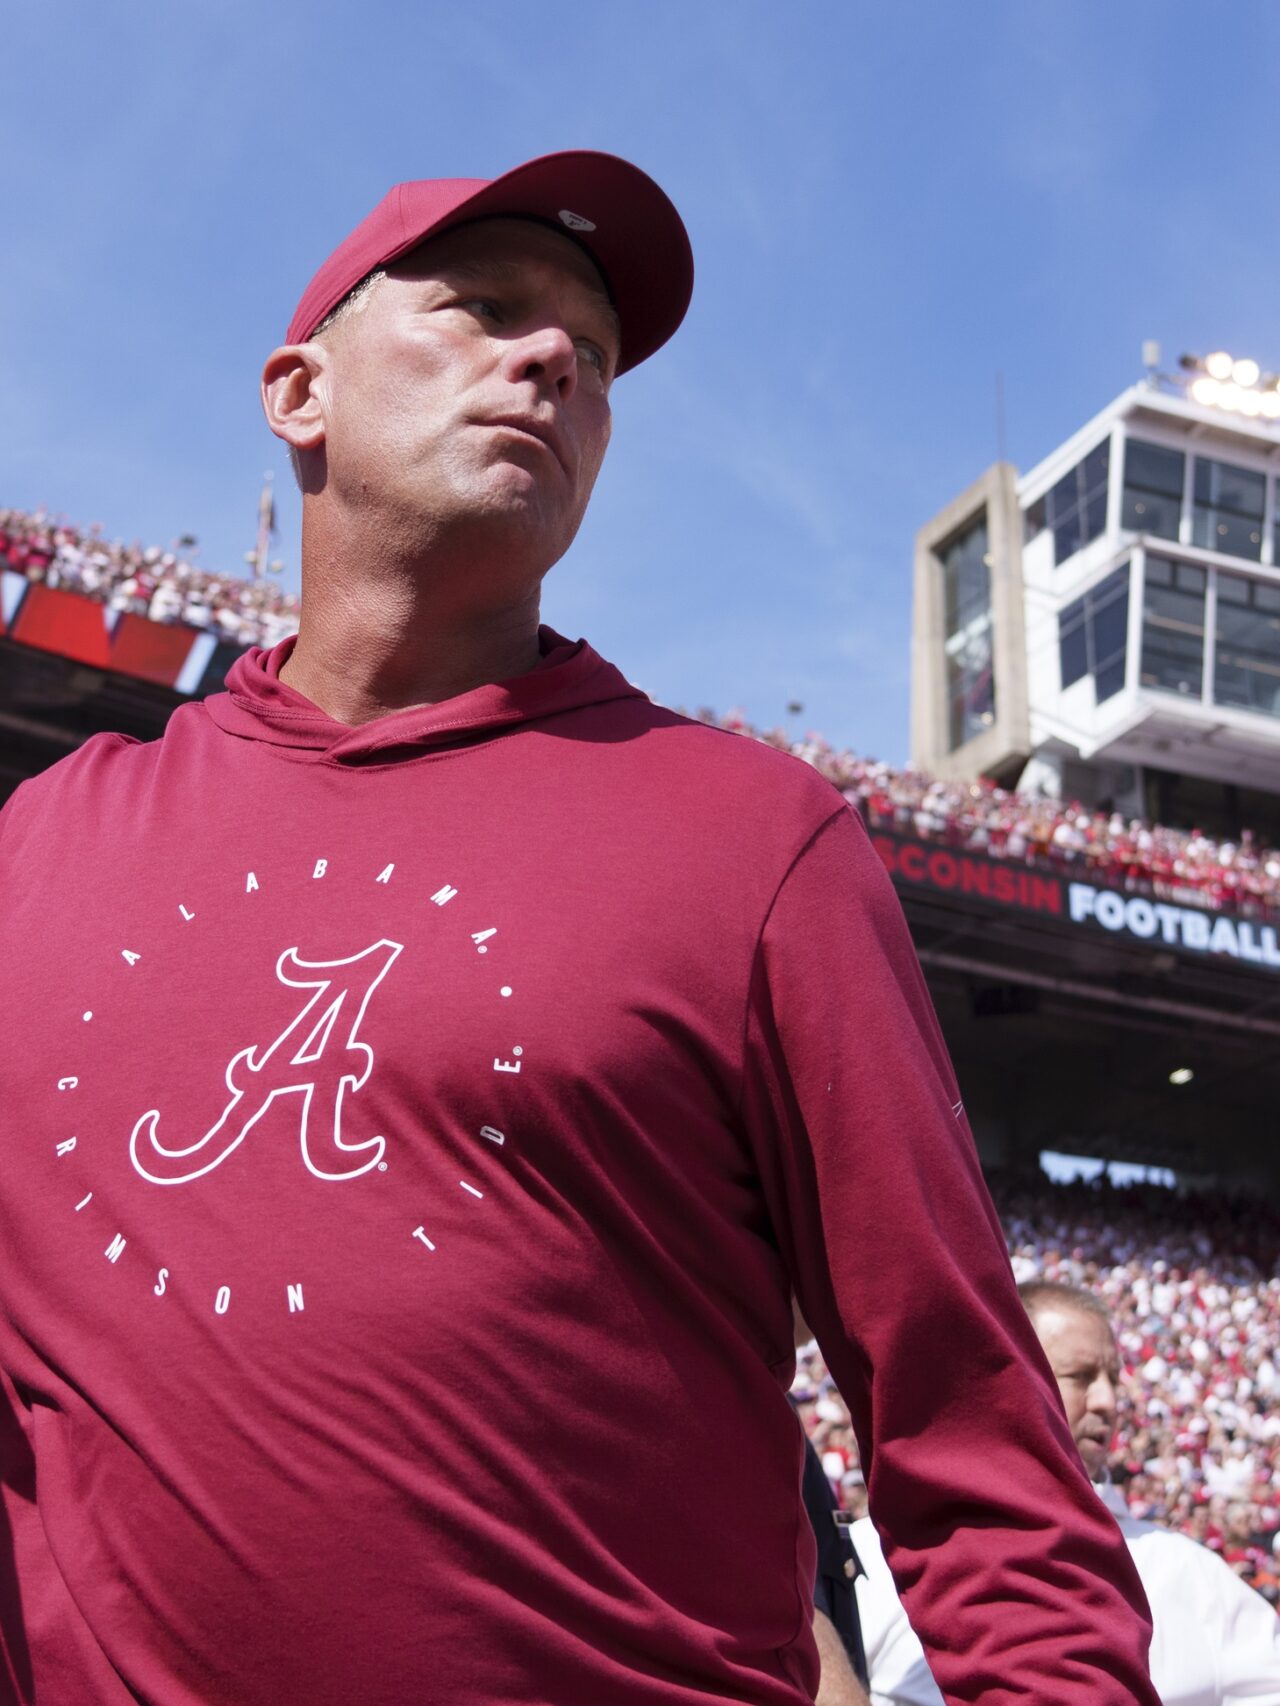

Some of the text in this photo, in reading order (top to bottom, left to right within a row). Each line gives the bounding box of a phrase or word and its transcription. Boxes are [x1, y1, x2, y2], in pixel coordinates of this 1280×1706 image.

[1069, 882, 1280, 967] FOOTBALL
[56, 1057, 521, 1315] CRIMSON TIDE
